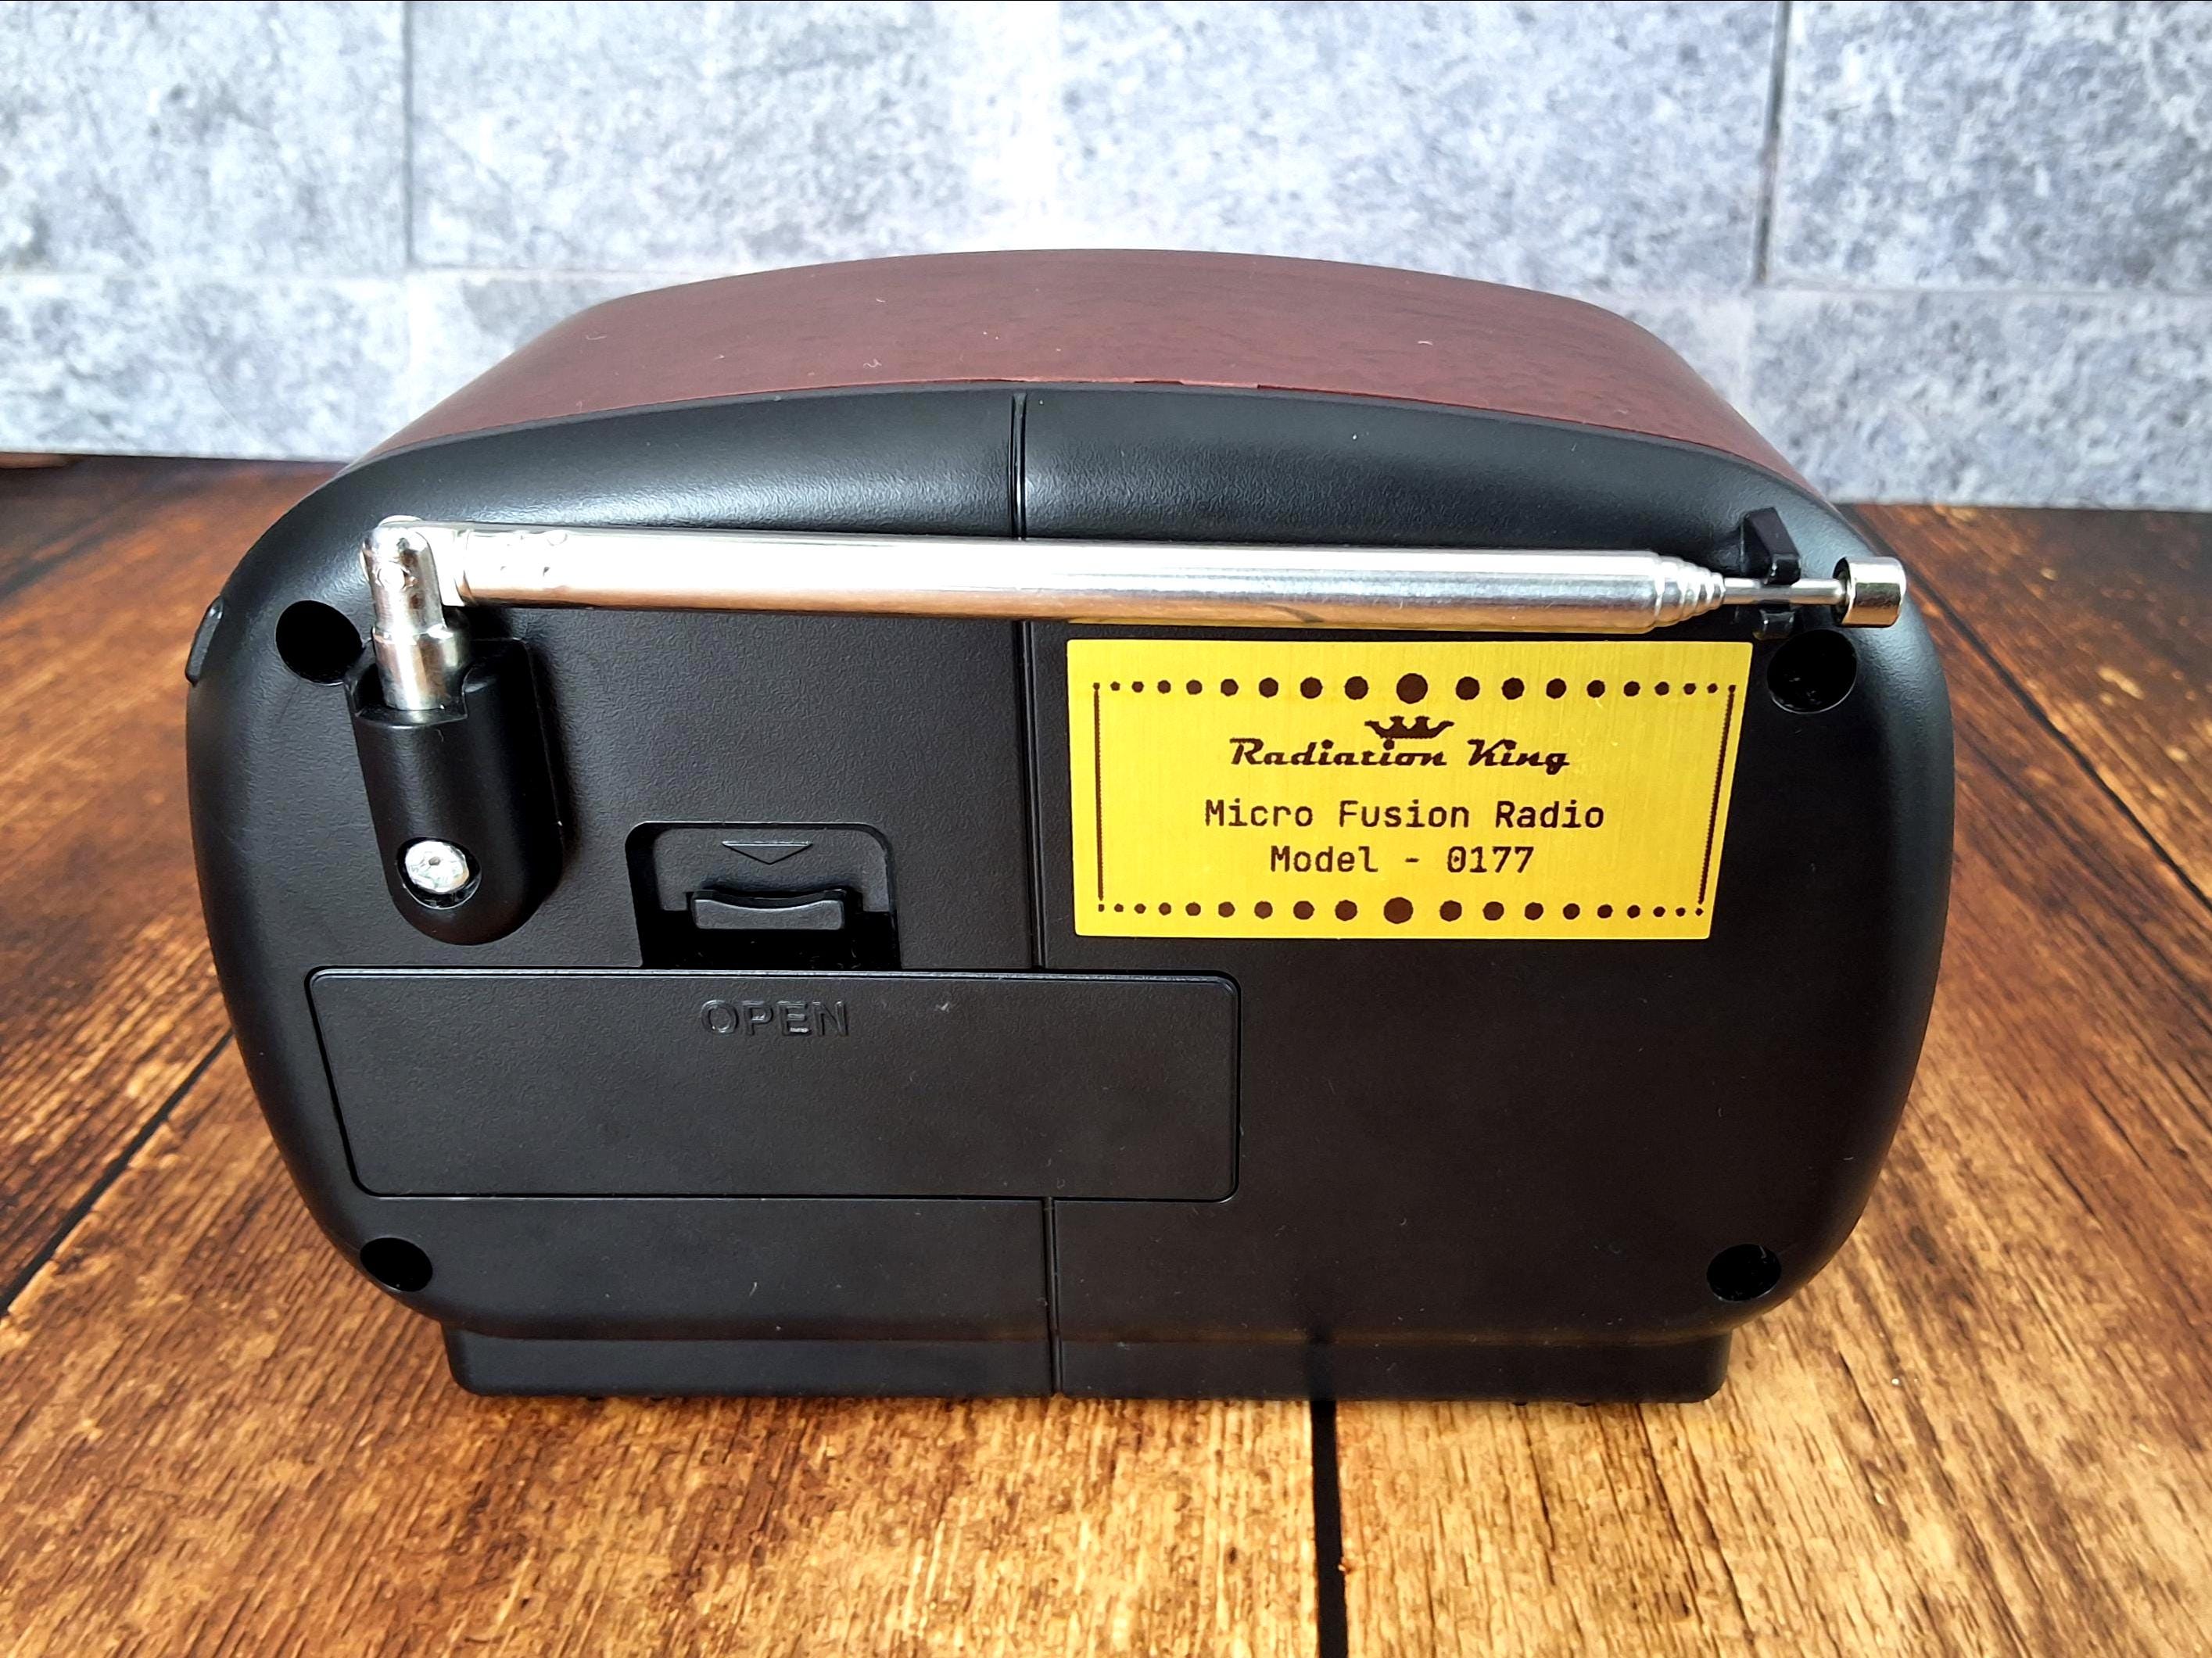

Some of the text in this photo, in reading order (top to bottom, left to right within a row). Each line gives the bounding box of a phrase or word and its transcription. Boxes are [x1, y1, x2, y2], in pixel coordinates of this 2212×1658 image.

[1229, 737, 1570, 775] Radiation King
[1204, 799, 1604, 829] Micro Fusion Radio
[1270, 845, 1378, 873] Model
[1447, 845, 1535, 874] 0177
[701, 998, 850, 1037] OPEN
